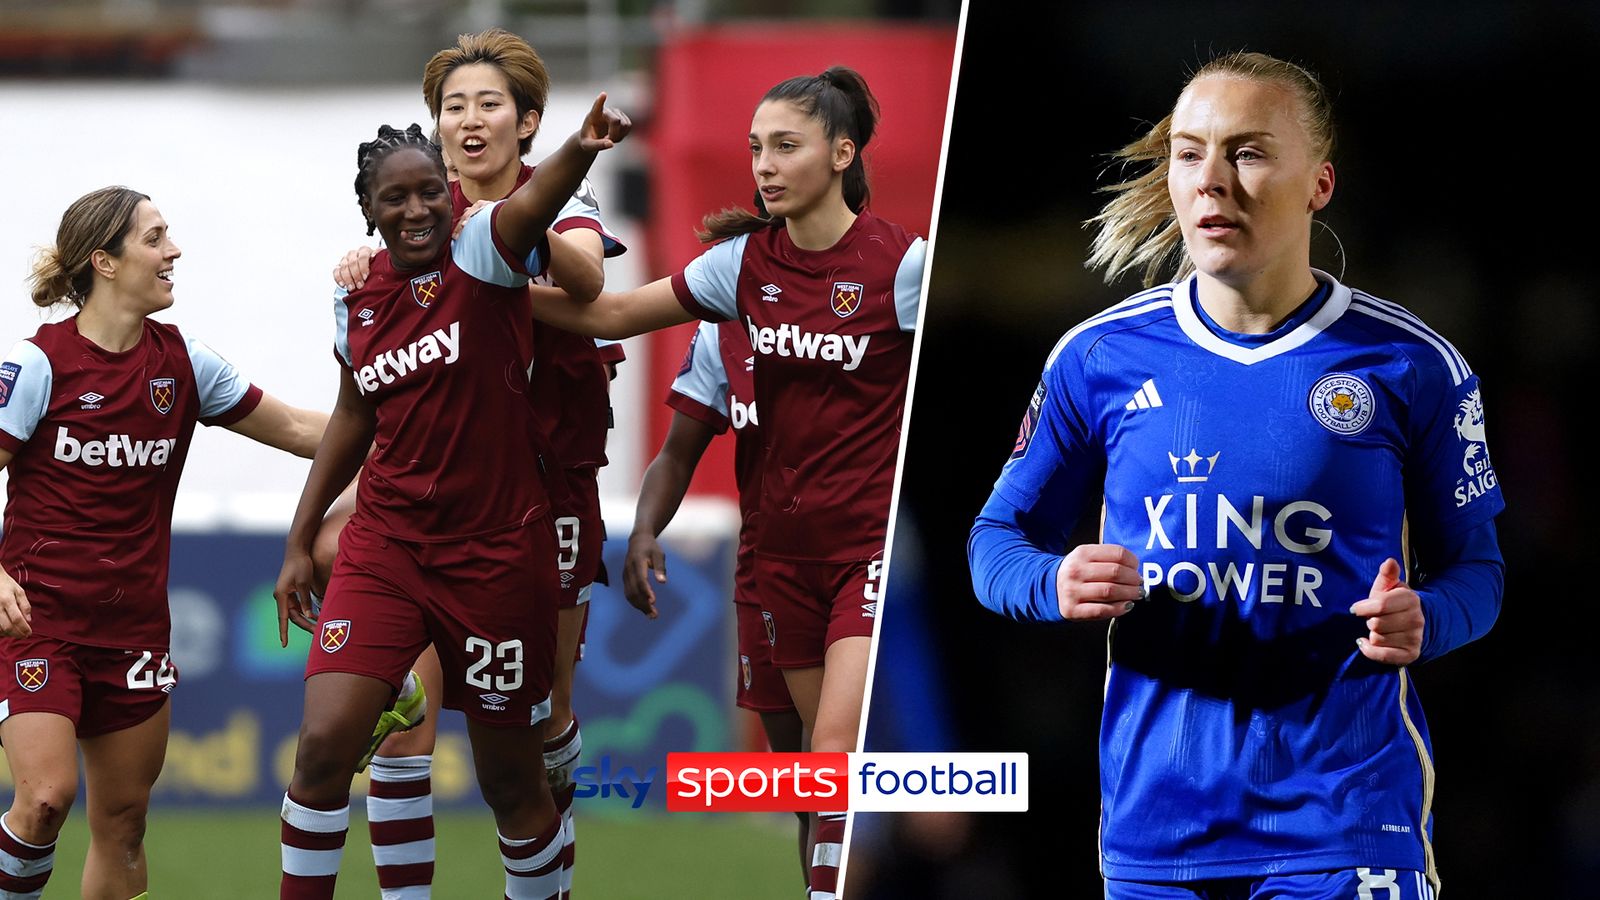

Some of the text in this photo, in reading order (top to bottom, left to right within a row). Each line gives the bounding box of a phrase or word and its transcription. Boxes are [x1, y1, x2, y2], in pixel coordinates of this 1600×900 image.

[746, 315, 870, 371] betway
[1316, 379, 1370, 406] LEICESTER CITY
[1315, 403, 1368, 430] FOOTBALL CLUB
[1144, 493, 1333, 553] KING
[1142, 561, 1323, 608] POWER
[465, 636, 523, 691] 23
[482, 703, 506, 711] umbro
